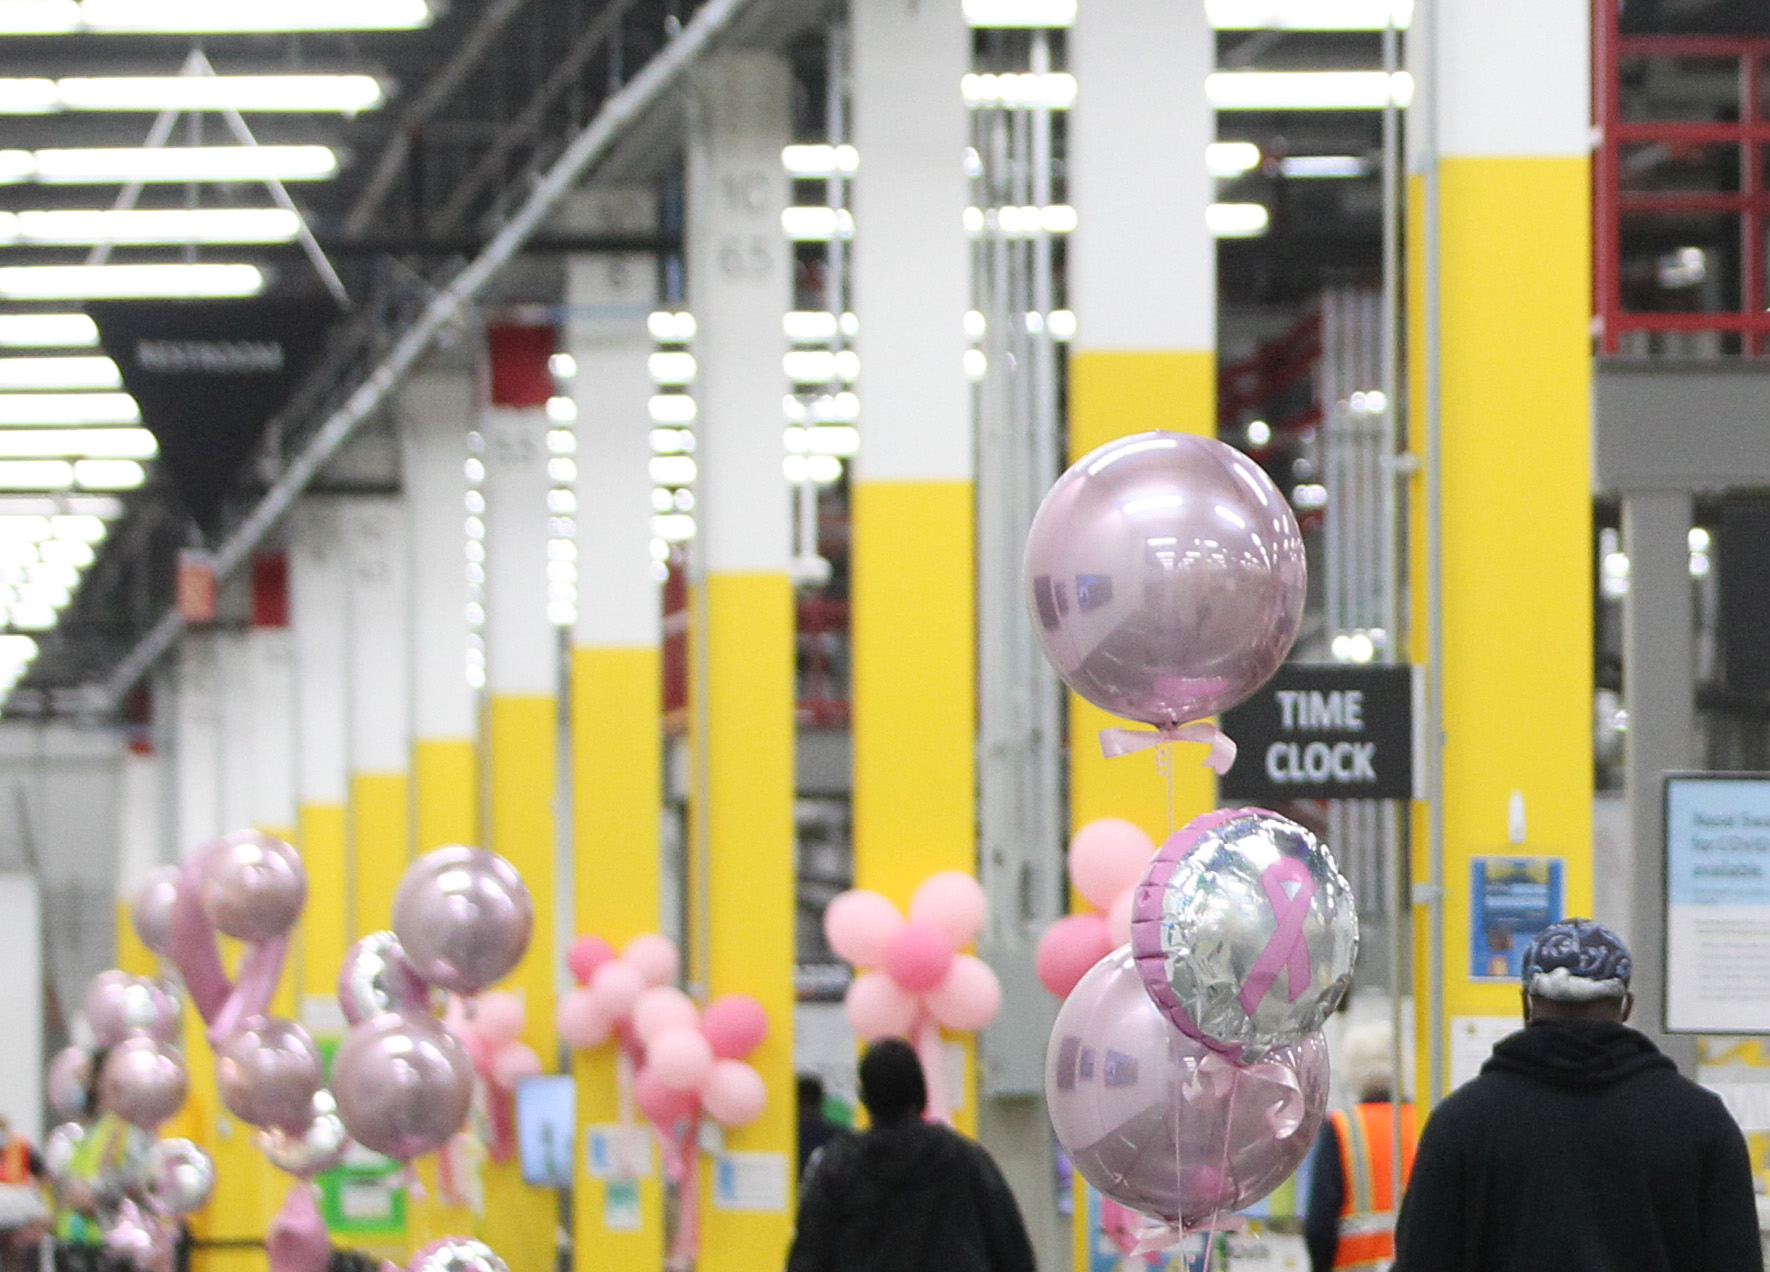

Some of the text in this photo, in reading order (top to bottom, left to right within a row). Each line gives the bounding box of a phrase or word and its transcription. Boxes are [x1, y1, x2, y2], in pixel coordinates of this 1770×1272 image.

[138, 340, 284, 372] RESTROOM
[1275, 689, 1364, 731] TIME
[1265, 741, 1377, 784] CLOCK
